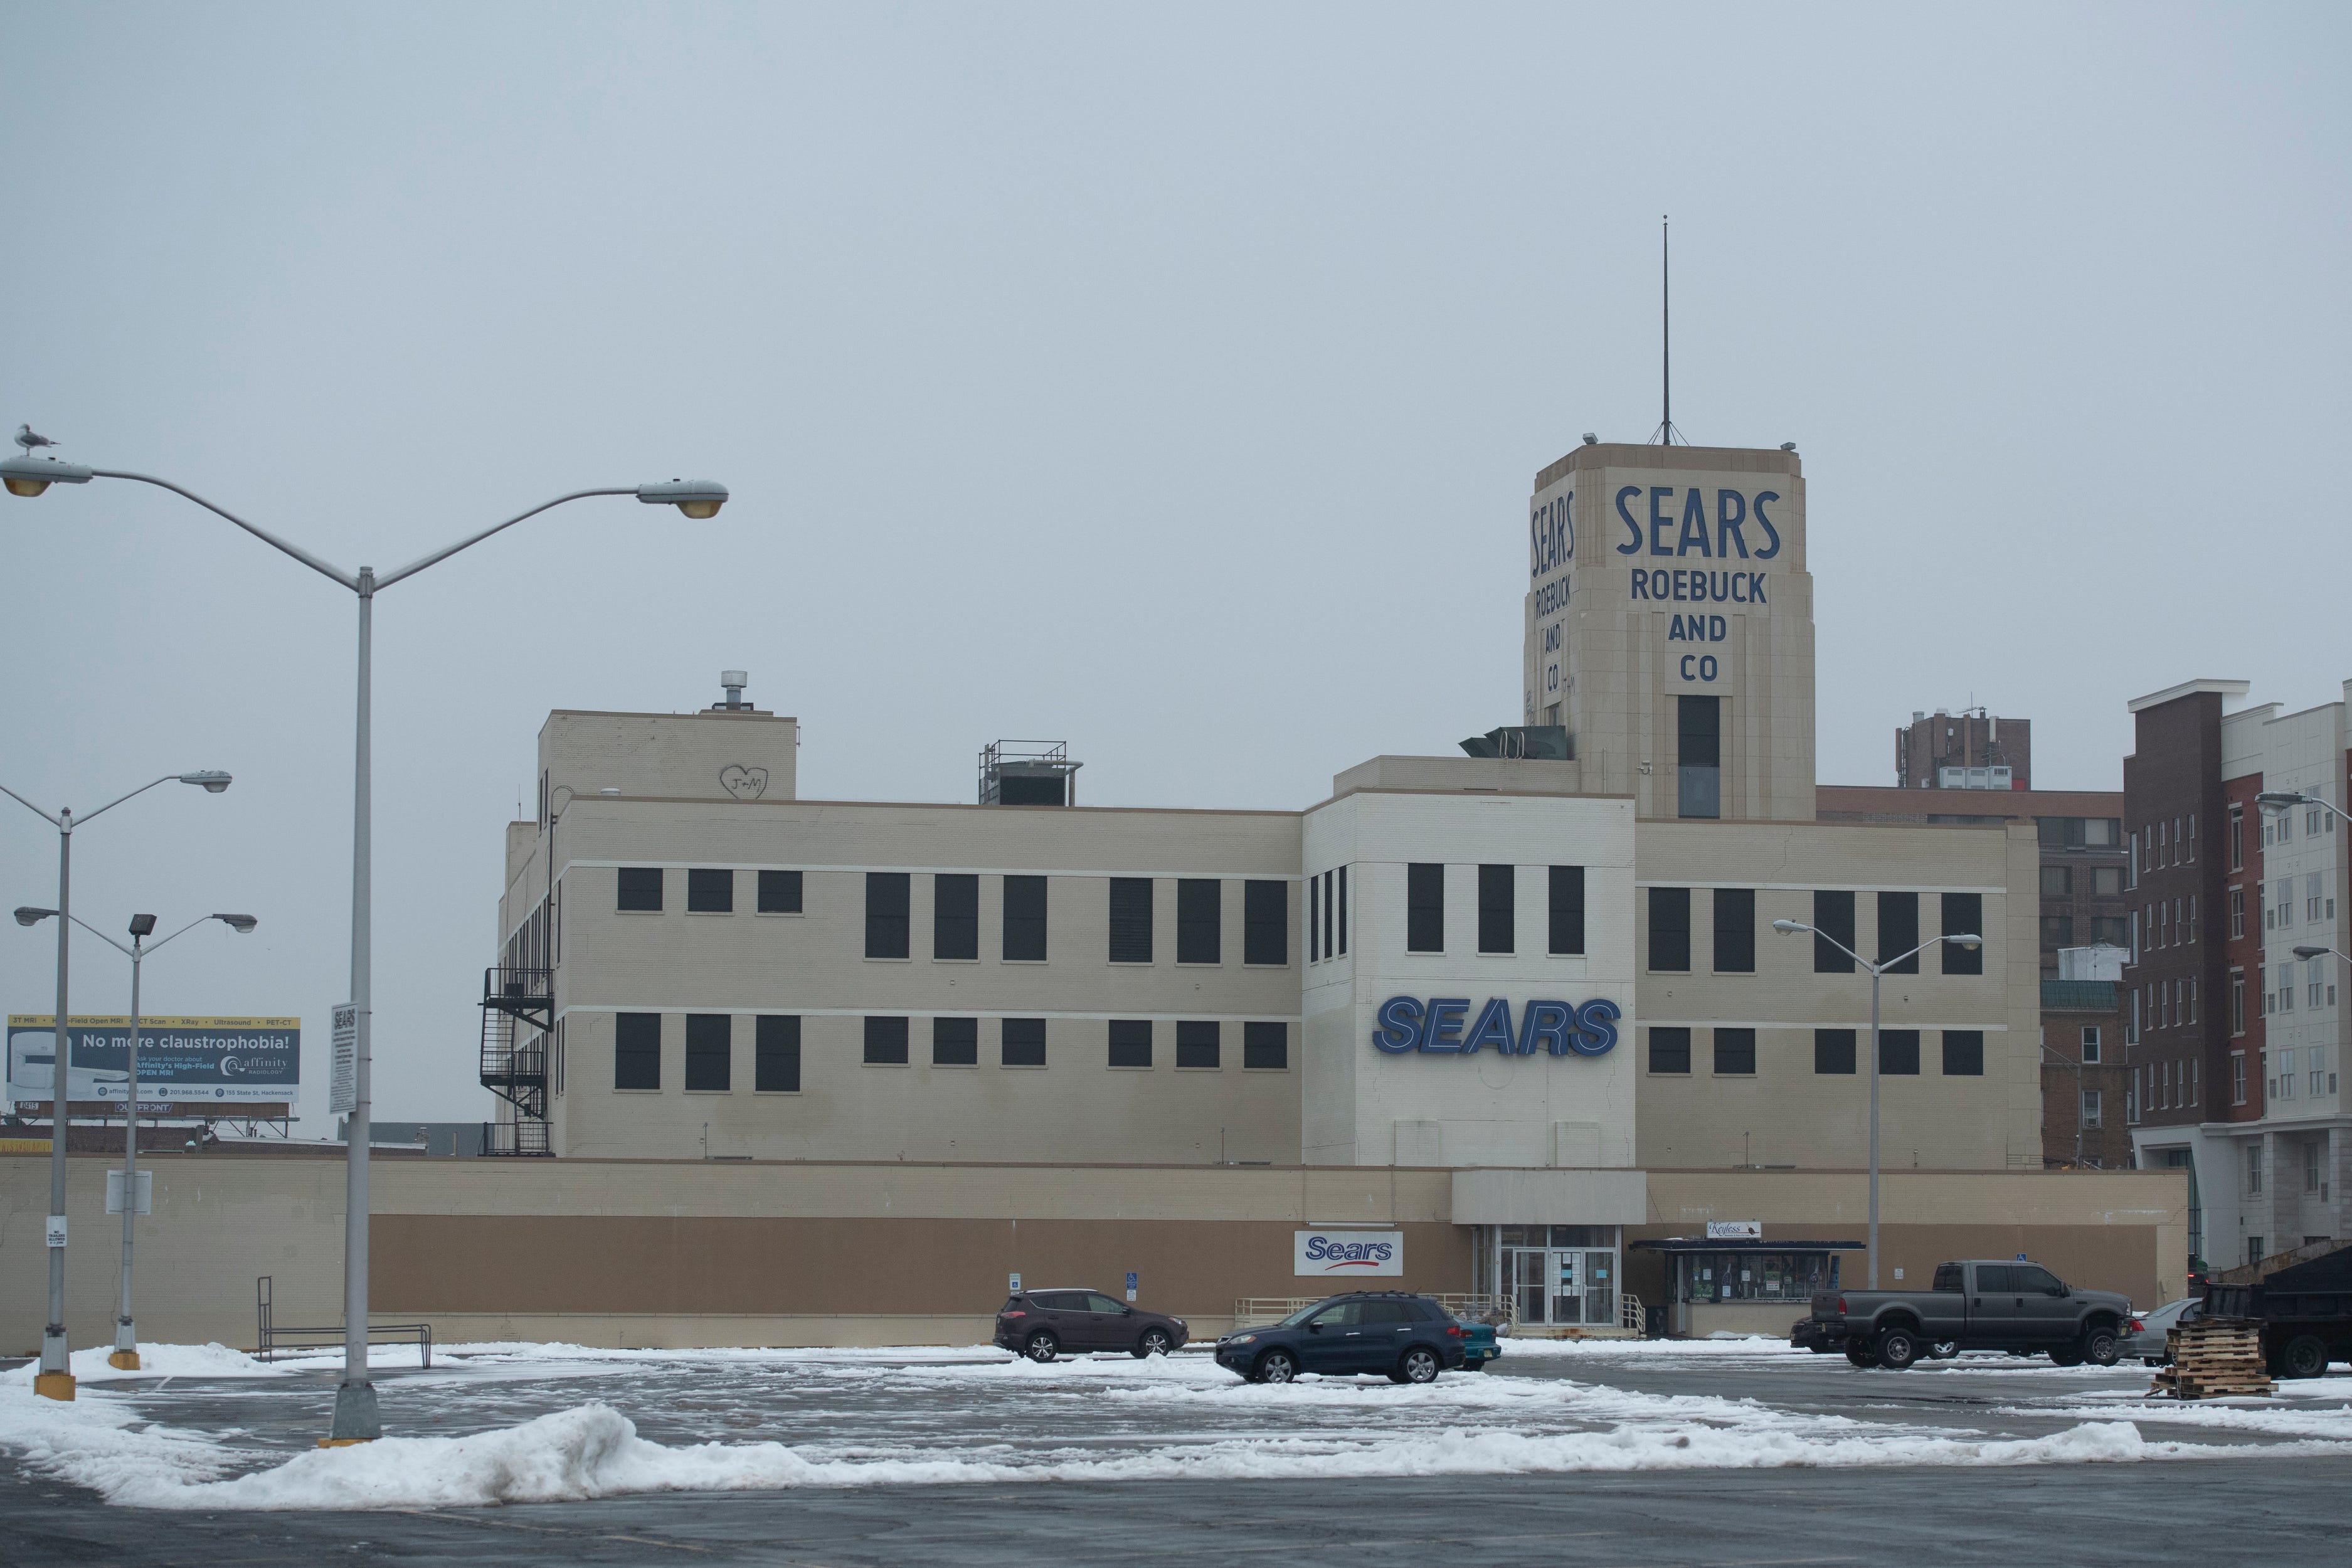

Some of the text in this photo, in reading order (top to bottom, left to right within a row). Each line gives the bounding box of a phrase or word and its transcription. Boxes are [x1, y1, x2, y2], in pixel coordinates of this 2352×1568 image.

[1532, 490, 1574, 579] SEARS
[1615, 485, 1781, 560] SEARS
[1535, 573, 1571, 620] ROEBUCK
[1631, 568, 1767, 603] ROEBUCK
[1545, 623, 1560, 655] AND
[1668, 614, 1726, 642] AND
[1548, 664, 1559, 692] CO
[1680, 654, 1717, 682] CO
[334, 1009, 355, 1030] SEARS
[1372, 995, 1621, 1056] SEARS
[83, 1034, 106, 1047] No
[159, 1035, 289, 1051] claustrophobia!
[244, 1057, 288, 1069] affinity
[1709, 1222, 1740, 1237] Keyless
[1305, 1236, 1392, 1261] Sears
